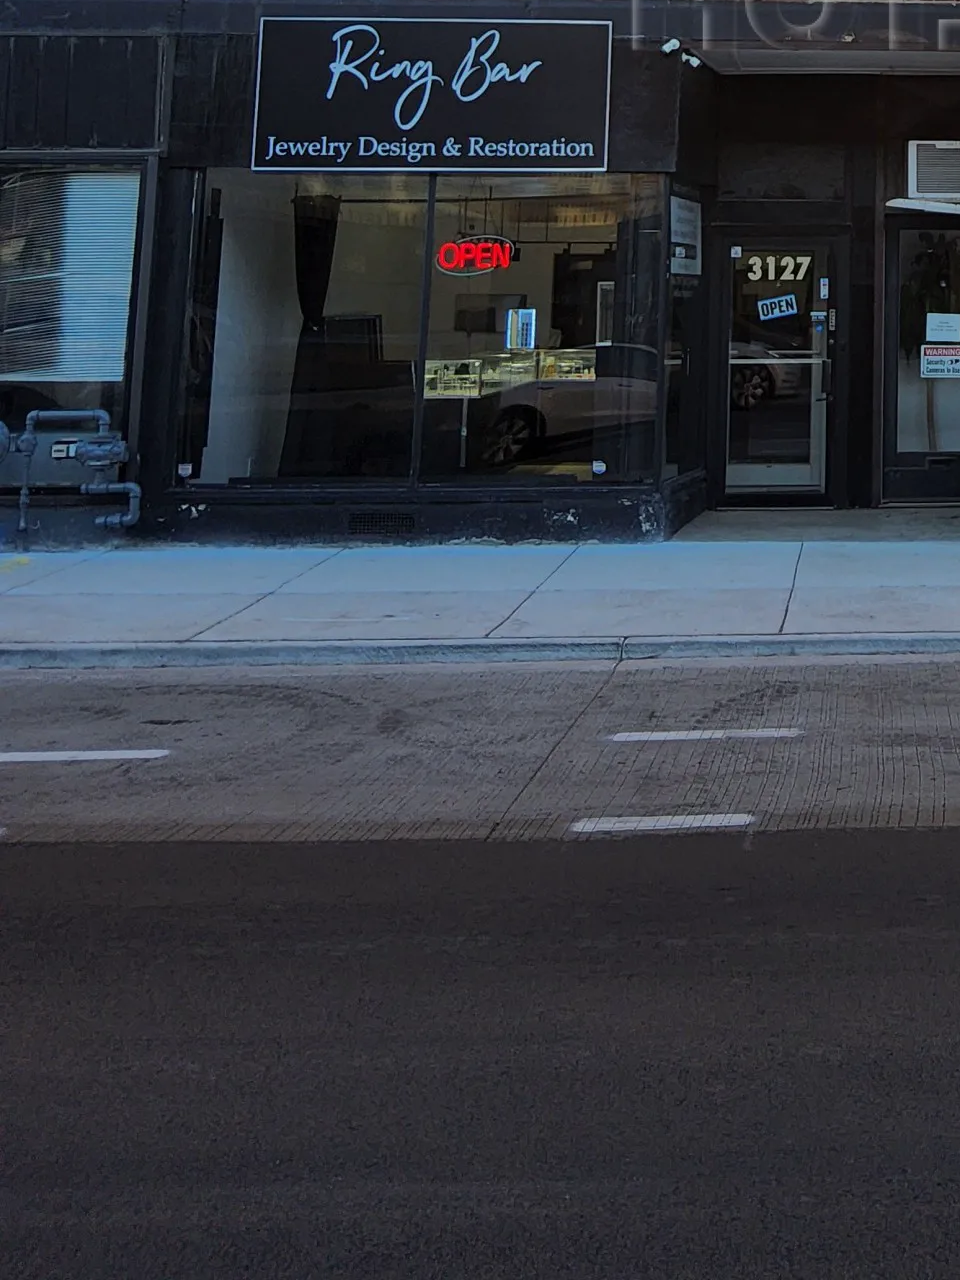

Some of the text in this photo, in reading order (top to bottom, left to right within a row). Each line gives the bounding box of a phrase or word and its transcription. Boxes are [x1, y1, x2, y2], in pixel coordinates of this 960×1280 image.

[326, 24, 542, 130] Ring Bar
[265, 136, 594, 163] Jewelry Design & Restoration
[438, 241, 511, 269] OPEN
[747, 255, 812, 281] 3127
[760, 297, 795, 318] OPEN
[926, 358, 946, 367] Security
